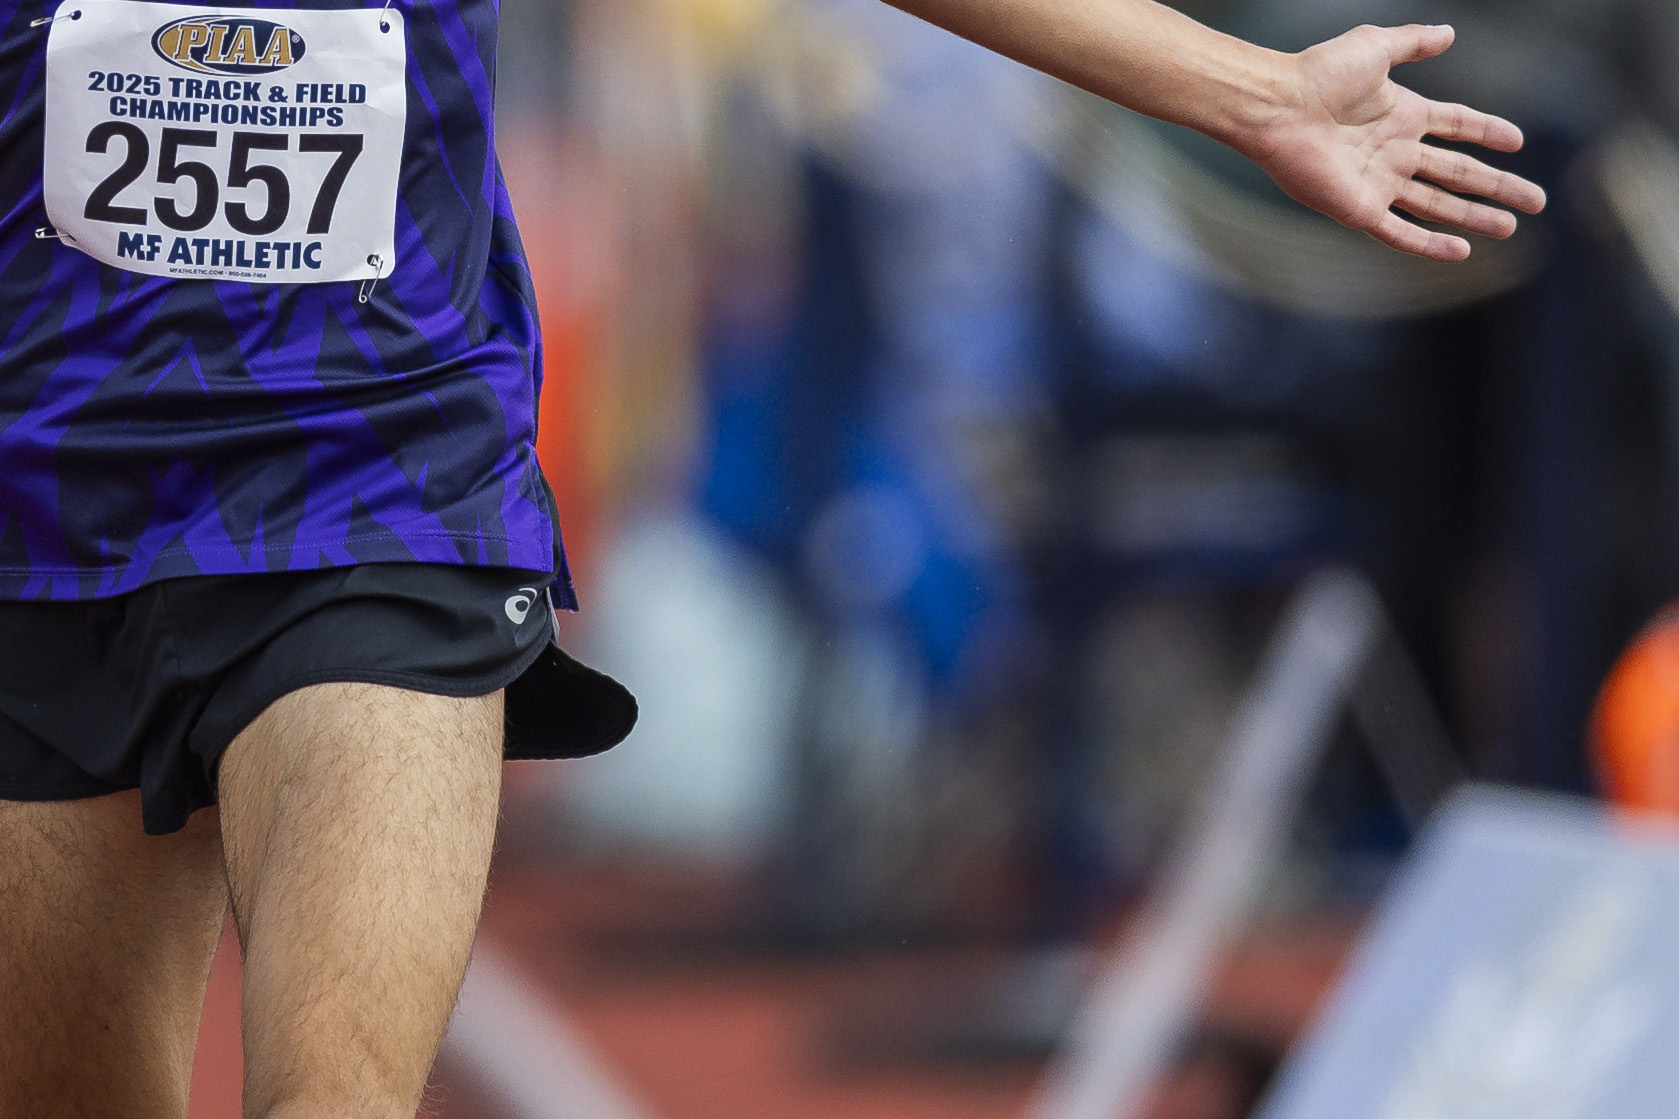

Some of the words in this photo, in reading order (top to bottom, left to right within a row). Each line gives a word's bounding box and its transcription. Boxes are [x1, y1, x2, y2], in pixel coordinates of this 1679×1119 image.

[87, 71, 161, 96] 2025
[168, 77, 262, 103] TRACK
[267, 85, 288, 103] &
[295, 83, 367, 104] FIELD
[109, 96, 344, 128] CHAMPIONSHIPS
[83, 120, 364, 236] 2557
[167, 236, 322, 270] ATHLETIC
